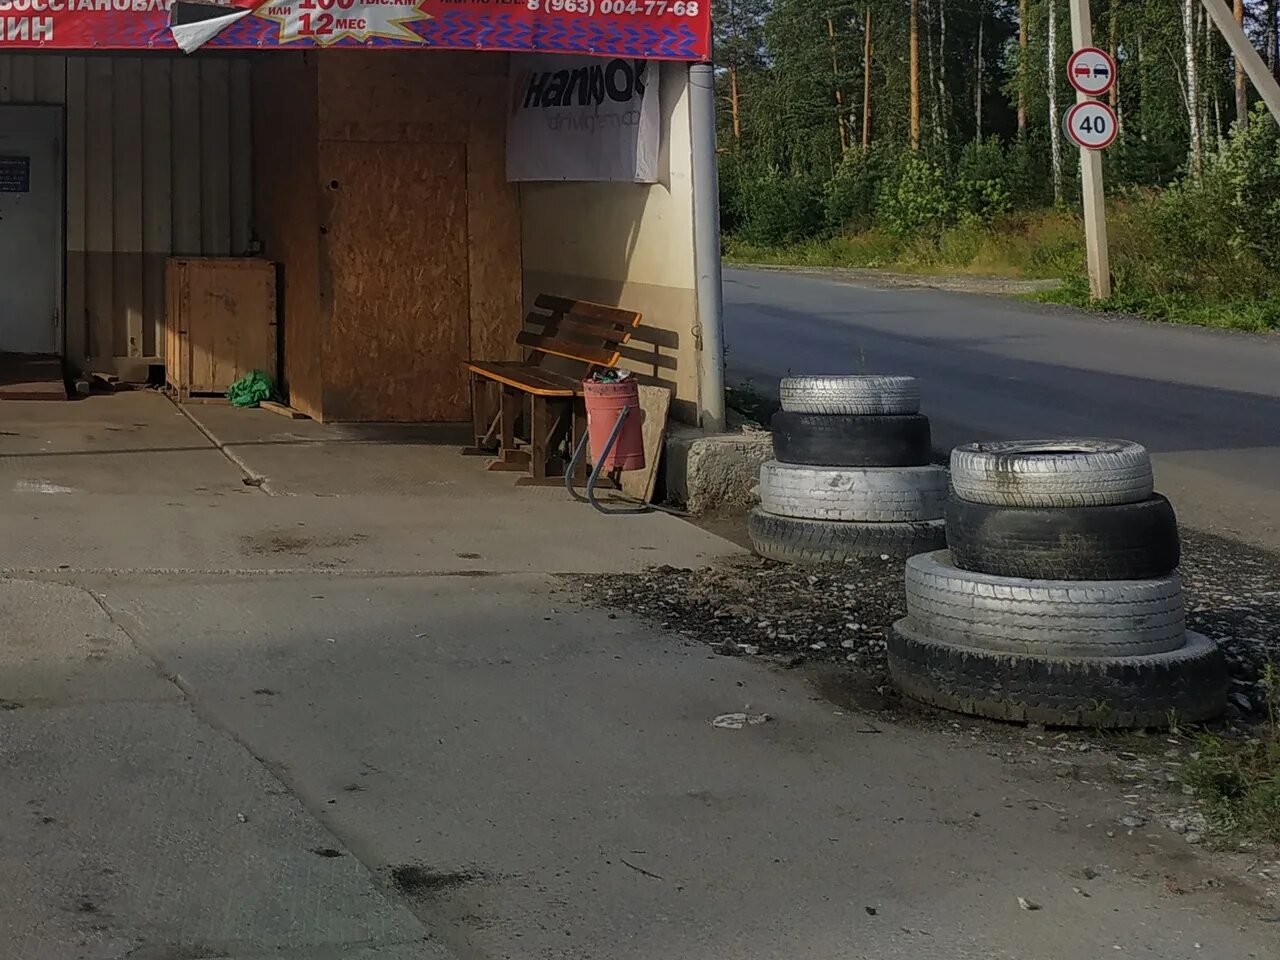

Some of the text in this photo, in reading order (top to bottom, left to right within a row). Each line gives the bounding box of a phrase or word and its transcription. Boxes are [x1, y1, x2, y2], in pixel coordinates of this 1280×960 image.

[268, 6, 291, 15] ИЛИ
[297, 13, 366, 35] 12 МЕС
[1079, 115, 1106, 134] 40
